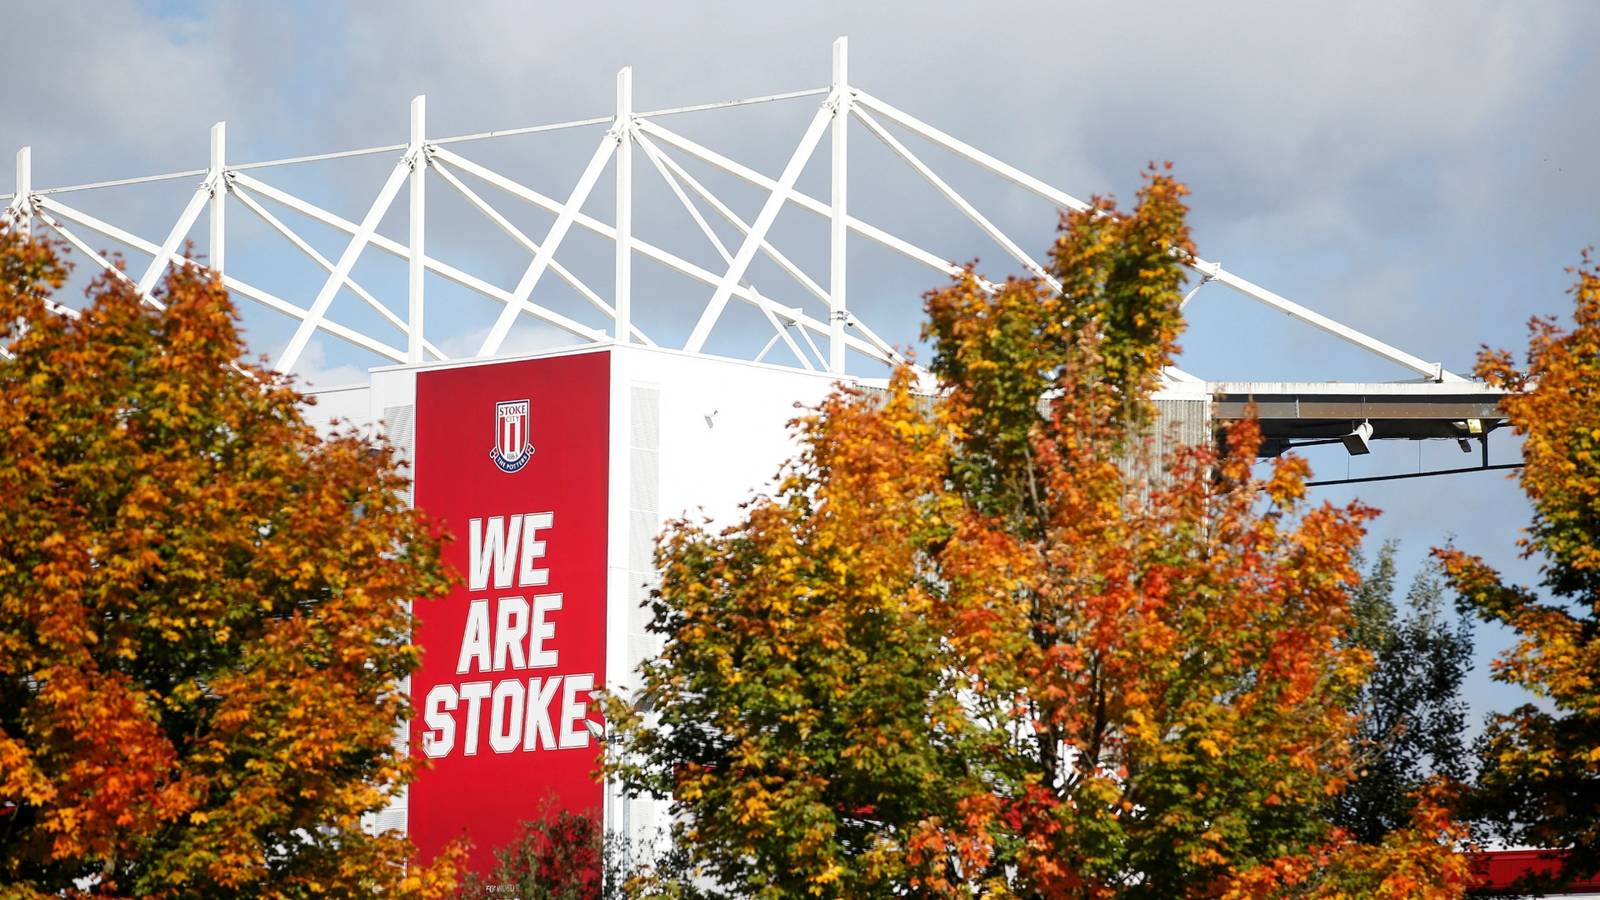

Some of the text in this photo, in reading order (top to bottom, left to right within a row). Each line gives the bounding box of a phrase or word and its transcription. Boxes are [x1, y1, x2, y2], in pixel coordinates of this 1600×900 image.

[499, 405, 526, 416] STOKE
[496, 457, 506, 468] THE
[469, 511, 554, 592] WE
[456, 592, 564, 674] ARE
[422, 673, 594, 758] STOKE
